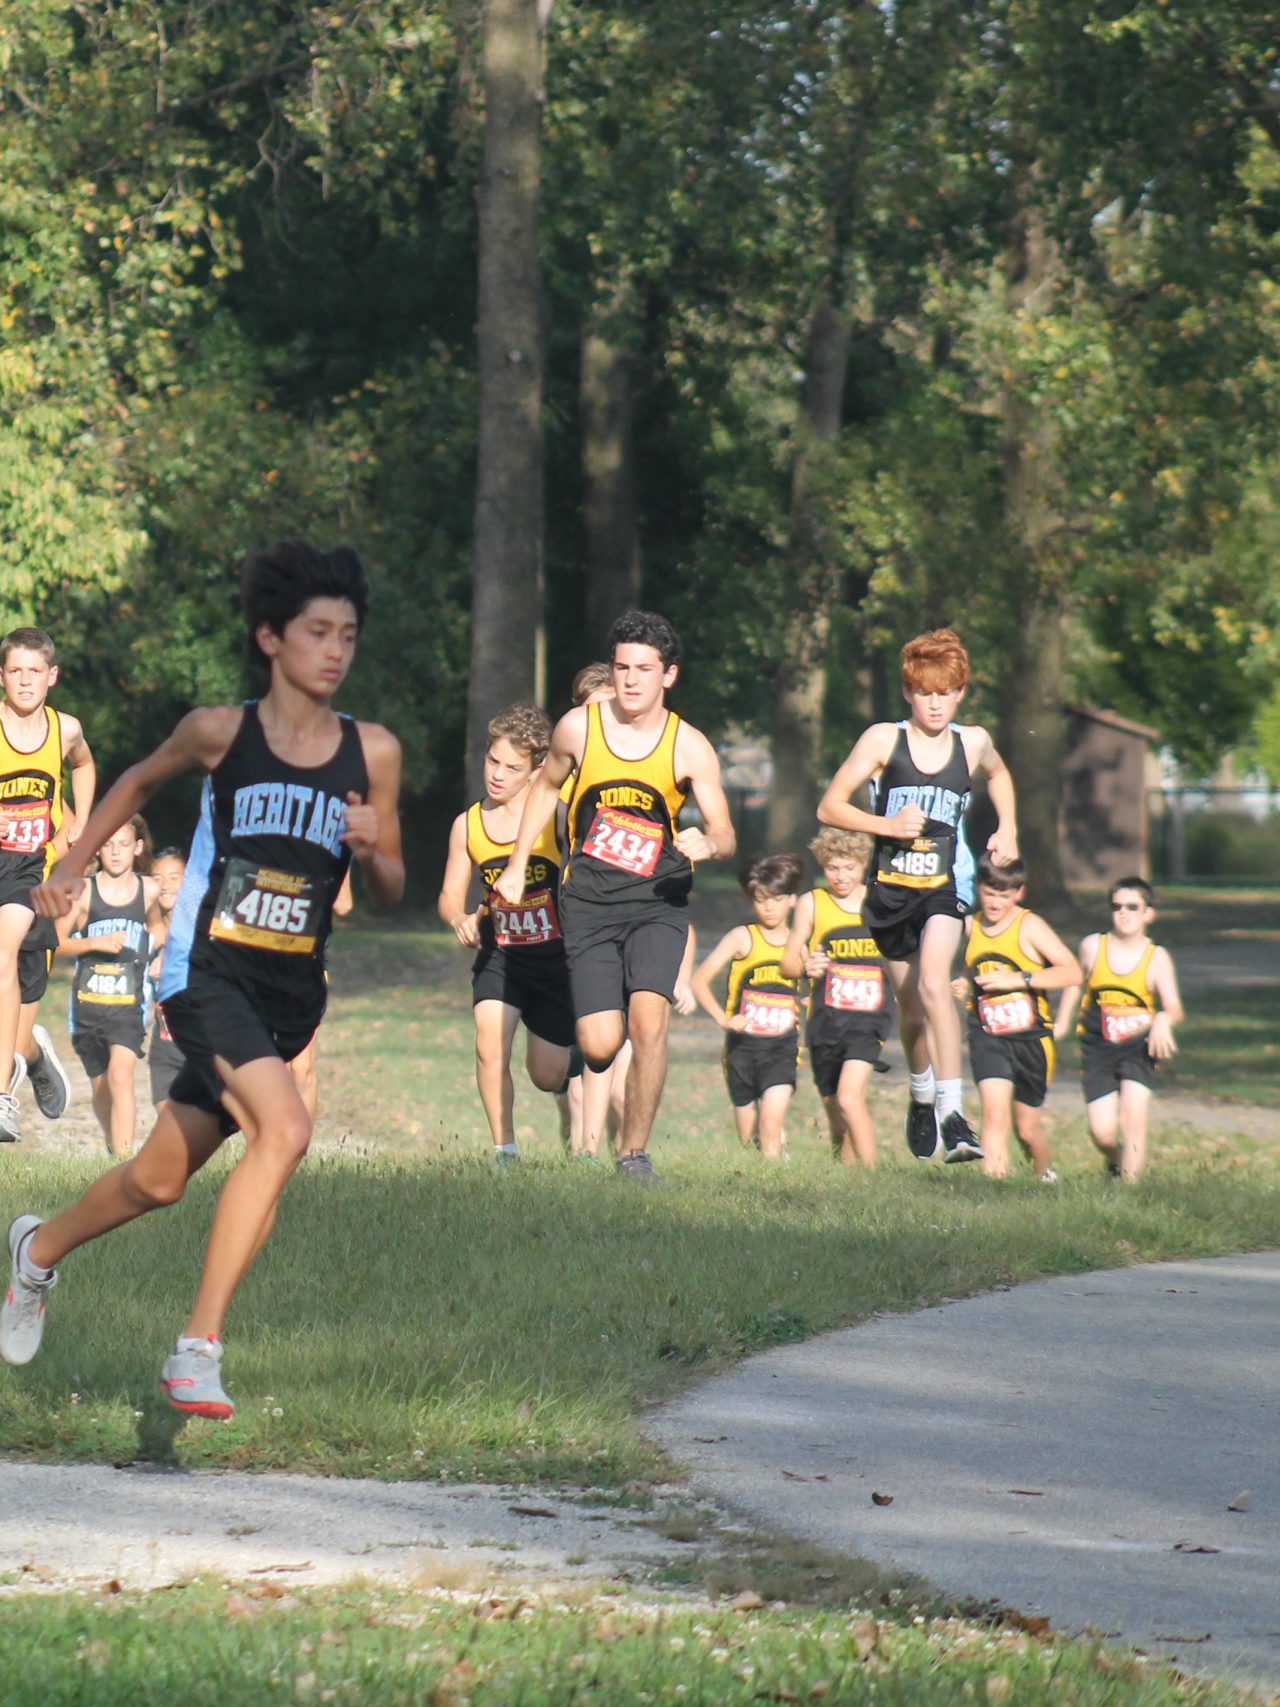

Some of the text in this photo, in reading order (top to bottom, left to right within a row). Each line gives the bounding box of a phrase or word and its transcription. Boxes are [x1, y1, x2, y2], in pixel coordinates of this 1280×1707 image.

[596, 786, 654, 811] JONES
[7, 818, 45, 843] 433
[593, 823, 656, 864] 2434
[890, 850, 938, 876] 4189
[236, 889, 312, 933] 4185
[496, 907, 552, 935] 2441
[826, 938, 881, 959] JONE
[87, 974, 128, 994] 4184
[827, 977, 878, 1002] 2443
